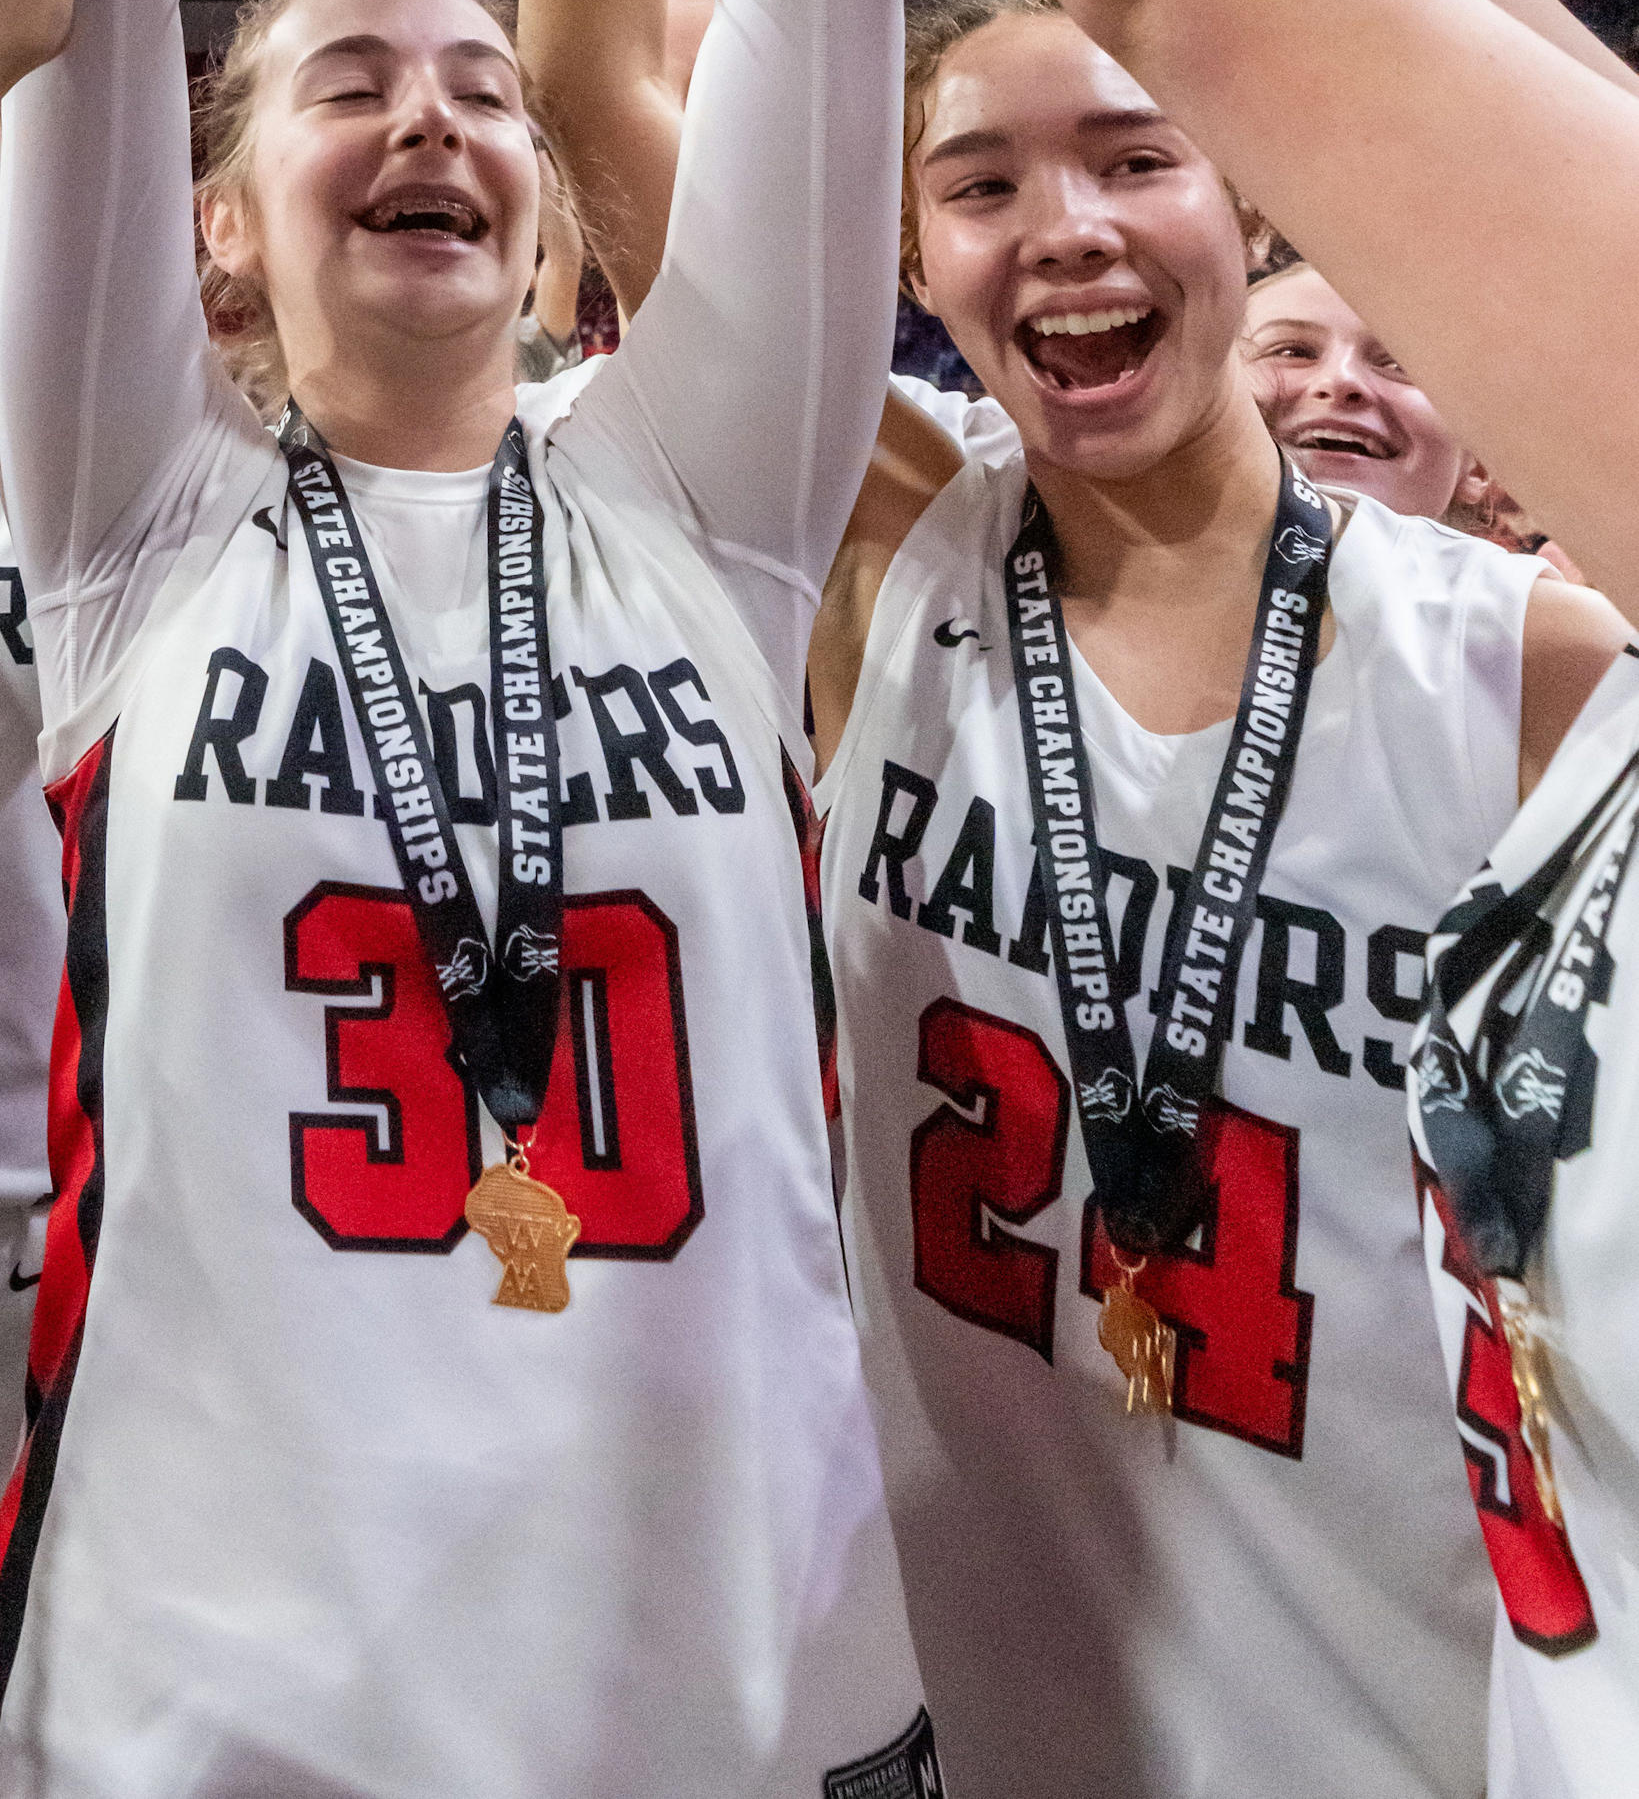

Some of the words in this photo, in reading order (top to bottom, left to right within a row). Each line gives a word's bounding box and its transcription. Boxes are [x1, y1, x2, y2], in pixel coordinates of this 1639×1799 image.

[173, 646, 747, 825] RADRS
[293, 461, 353, 551] STATE
[325, 554, 458, 905] CHAMPIONSHIPS
[498, 465, 543, 722] CHAMPIONSHIPS
[1013, 550, 1059, 667] STATE
[505, 731, 551, 886] STATE
[1027, 674, 1115, 1032] CHAMPIONSHIPS
[1166, 905, 1237, 1059] STATE
[1202, 586, 1309, 905] CHAMPIONSHIPS
[282, 880, 708, 1263] 30
[908, 991, 1317, 1463] 24
